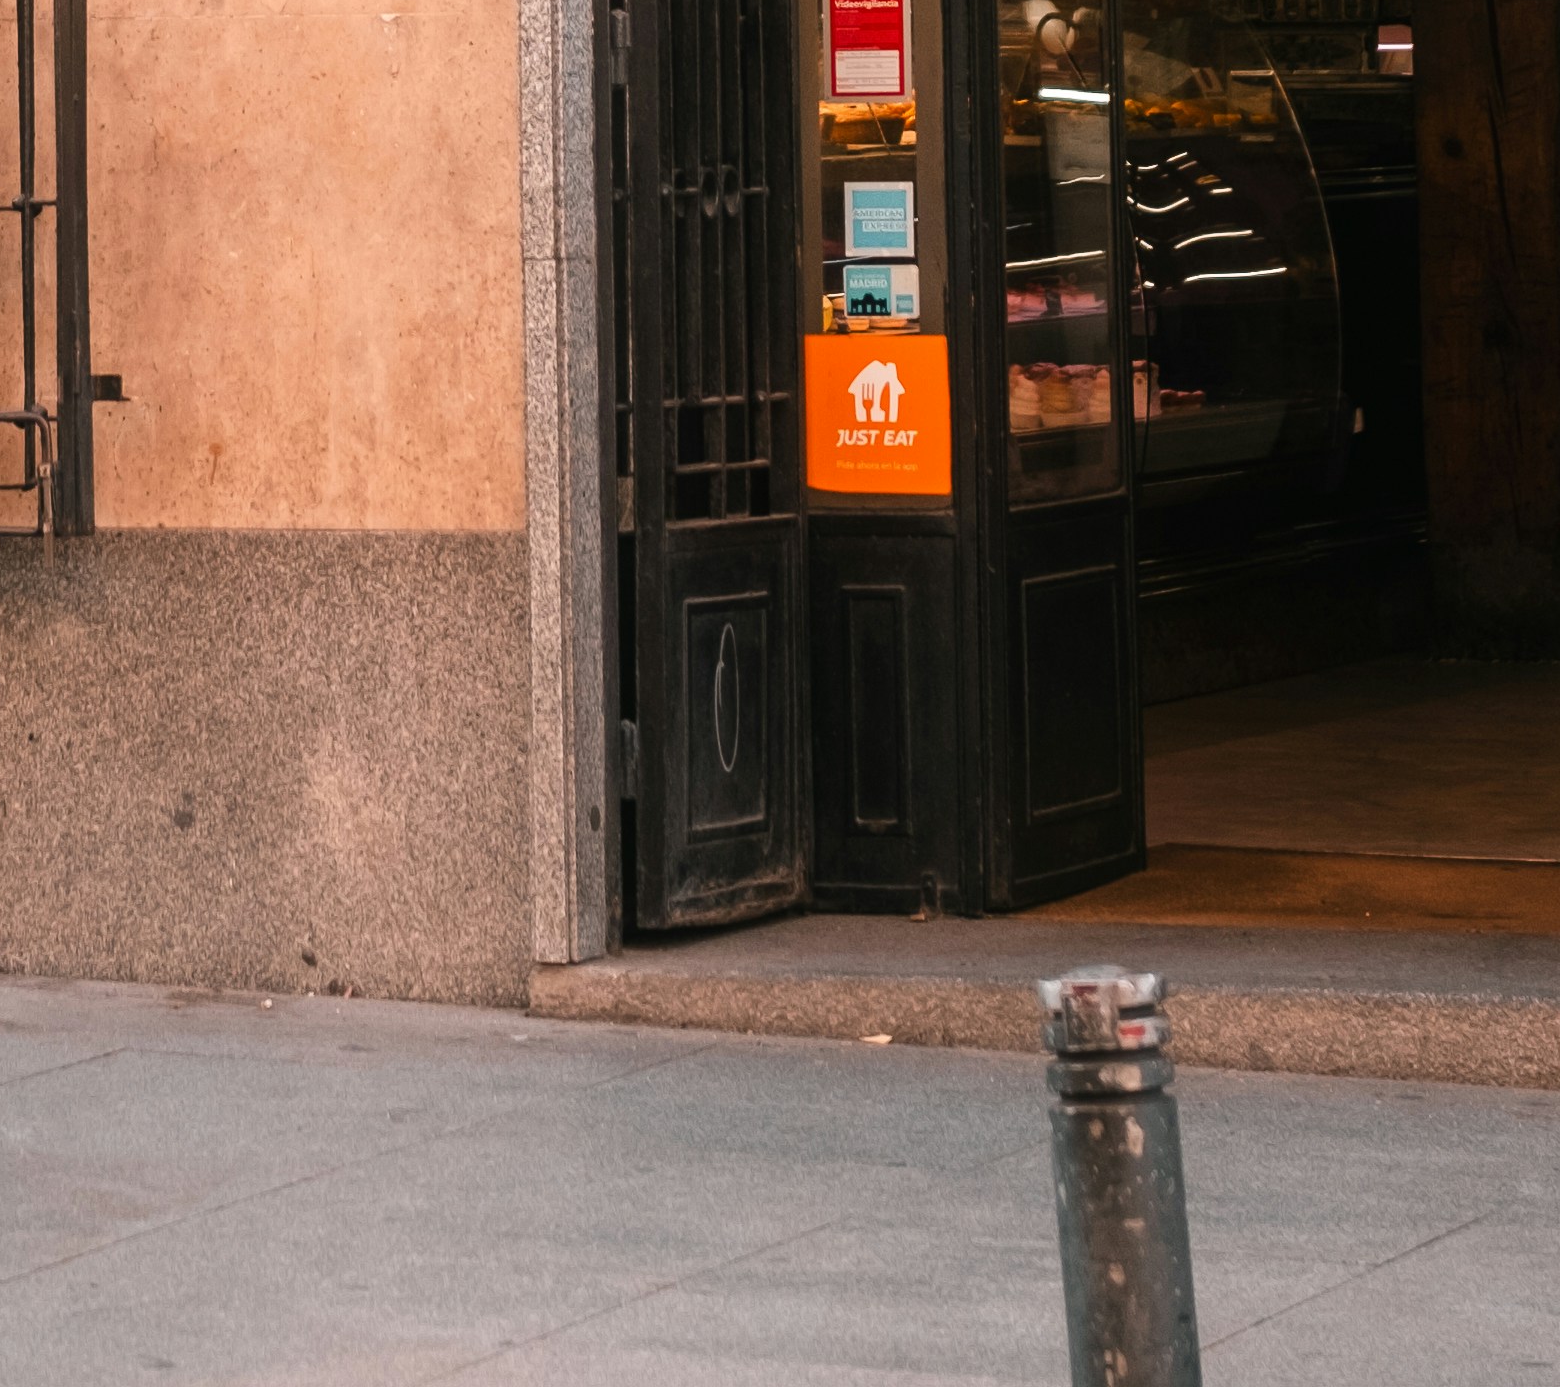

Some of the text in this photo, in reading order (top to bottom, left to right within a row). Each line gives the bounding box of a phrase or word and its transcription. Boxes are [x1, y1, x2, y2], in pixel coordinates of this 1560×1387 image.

[834, 0, 899, 9] Videovigilancia
[853, 209, 904, 218] AMERICAN
[864, 221, 908, 230] EXPRESS
[849, 278, 888, 288] MADRID
[836, 429, 918, 447] JUST EAT
